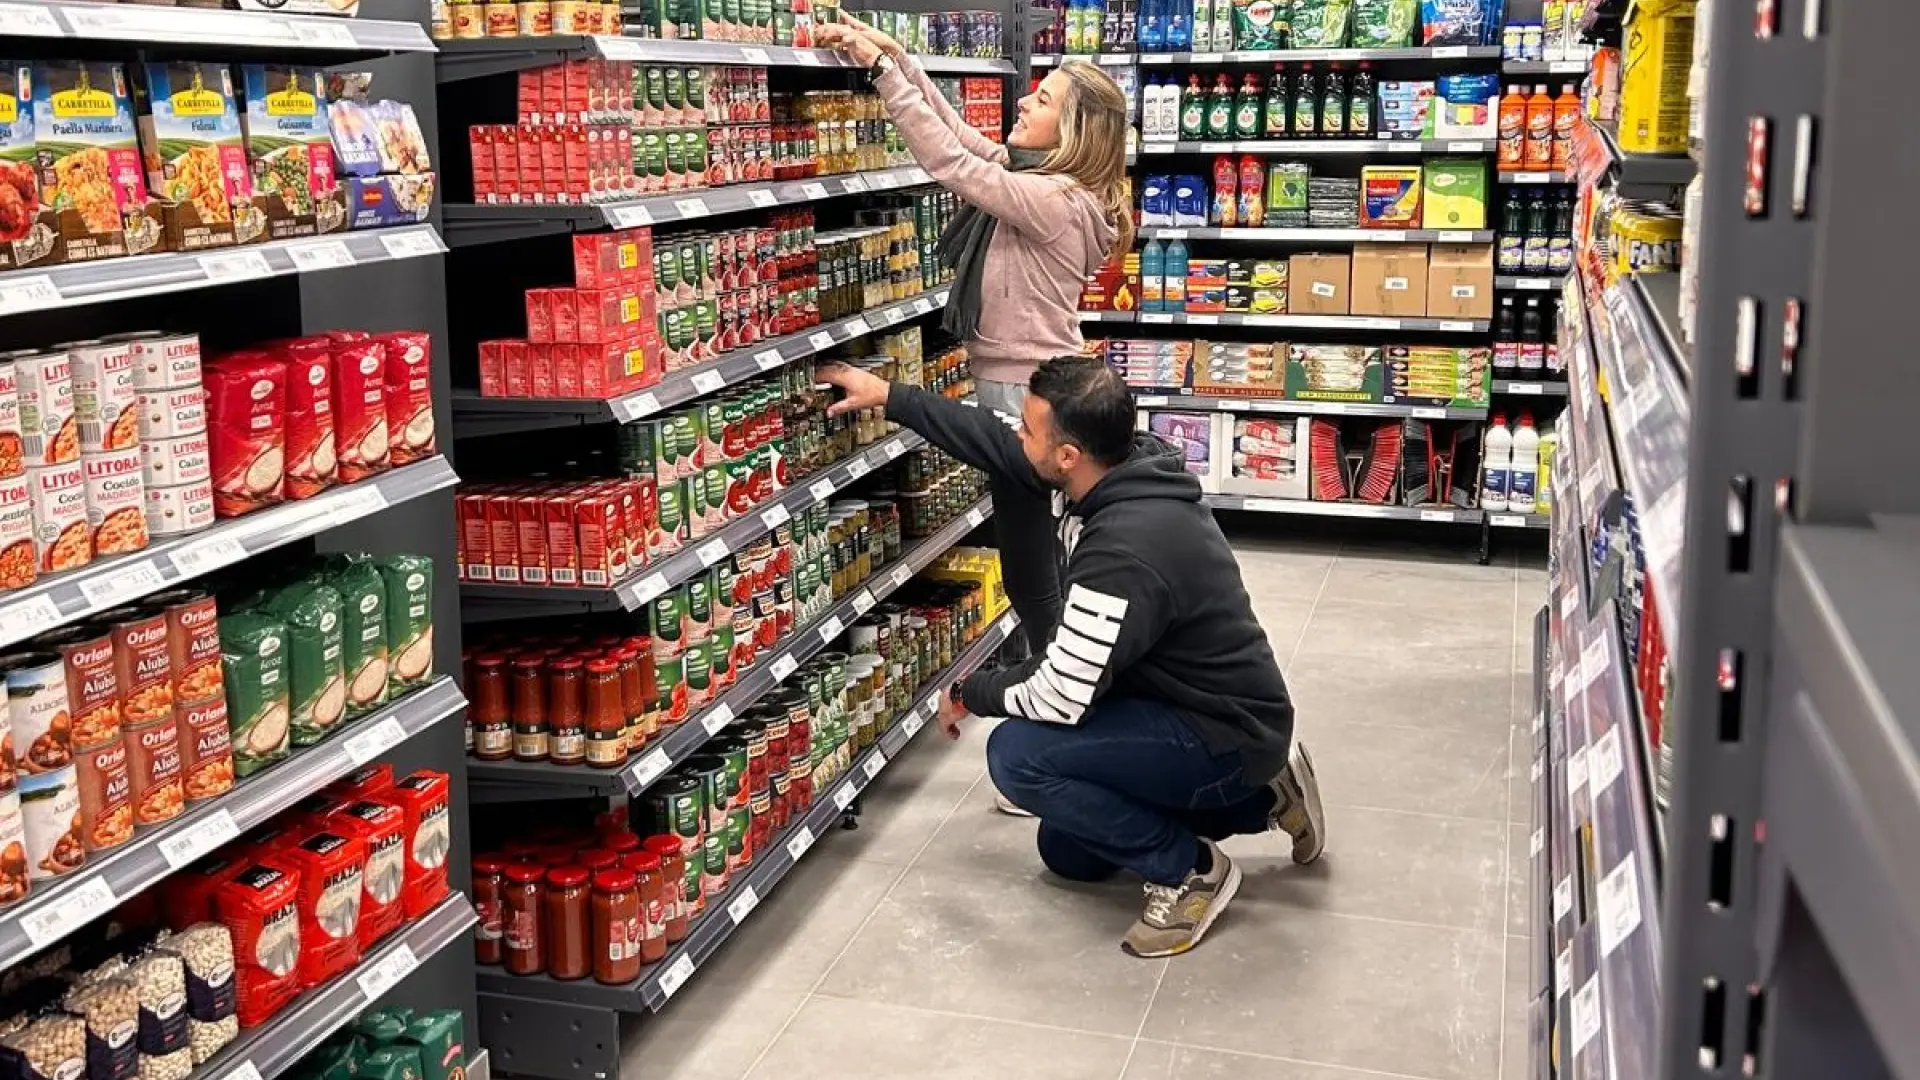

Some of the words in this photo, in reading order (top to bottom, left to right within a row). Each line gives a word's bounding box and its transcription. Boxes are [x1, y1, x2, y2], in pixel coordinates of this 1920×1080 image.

[57, 98, 112, 109] CARRETILLA
[177, 98, 220, 108] CARRETILLA
[271, 98, 313, 107] CARRETILLA
[52, 123, 83, 134] Paella
[85, 123, 123, 134] Marinera
[103, 477, 140, 491] Cocido
